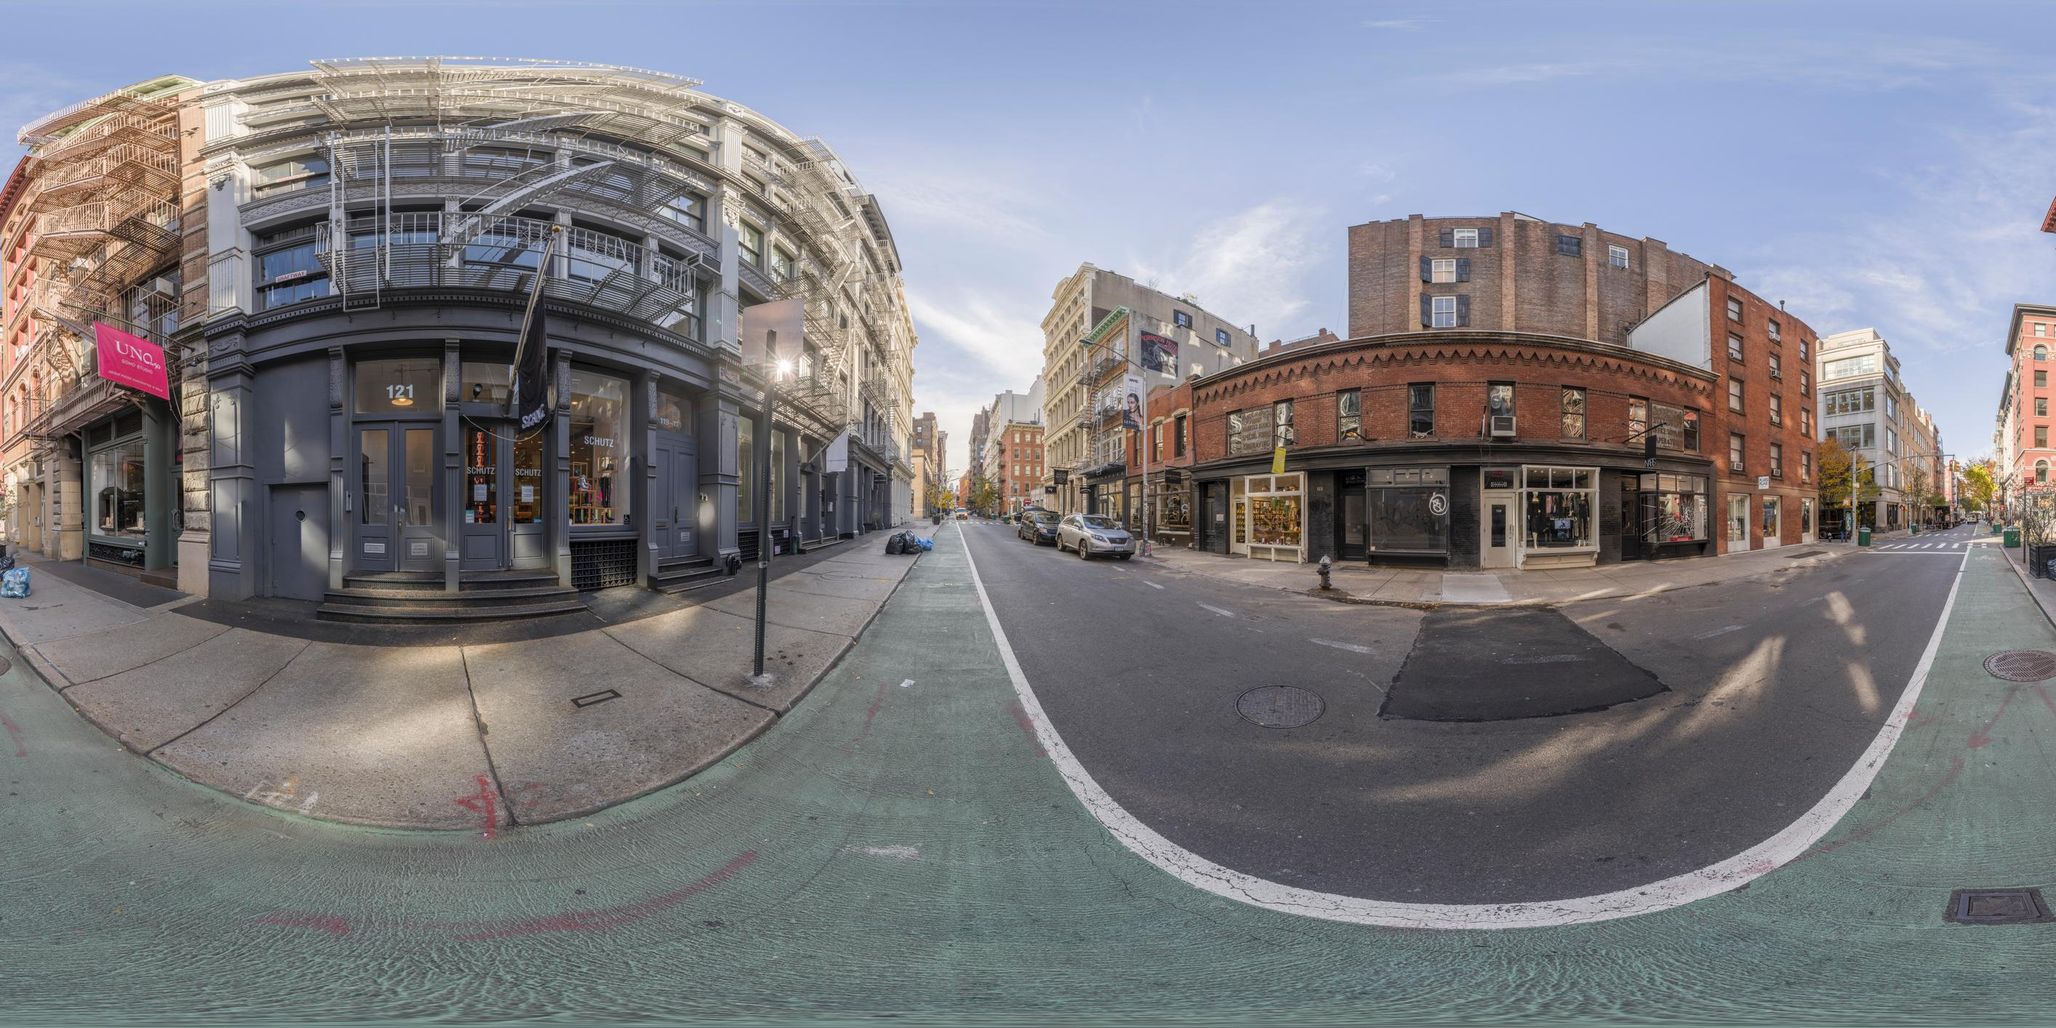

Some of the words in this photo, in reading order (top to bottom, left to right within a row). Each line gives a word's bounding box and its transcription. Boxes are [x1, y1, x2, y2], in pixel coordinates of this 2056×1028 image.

[386, 384, 414, 399] 121
[584, 435, 615, 448] SCHUTZ
[466, 466, 496, 475] SCHUTZ
[515, 468, 542, 477] SCHUTZ
